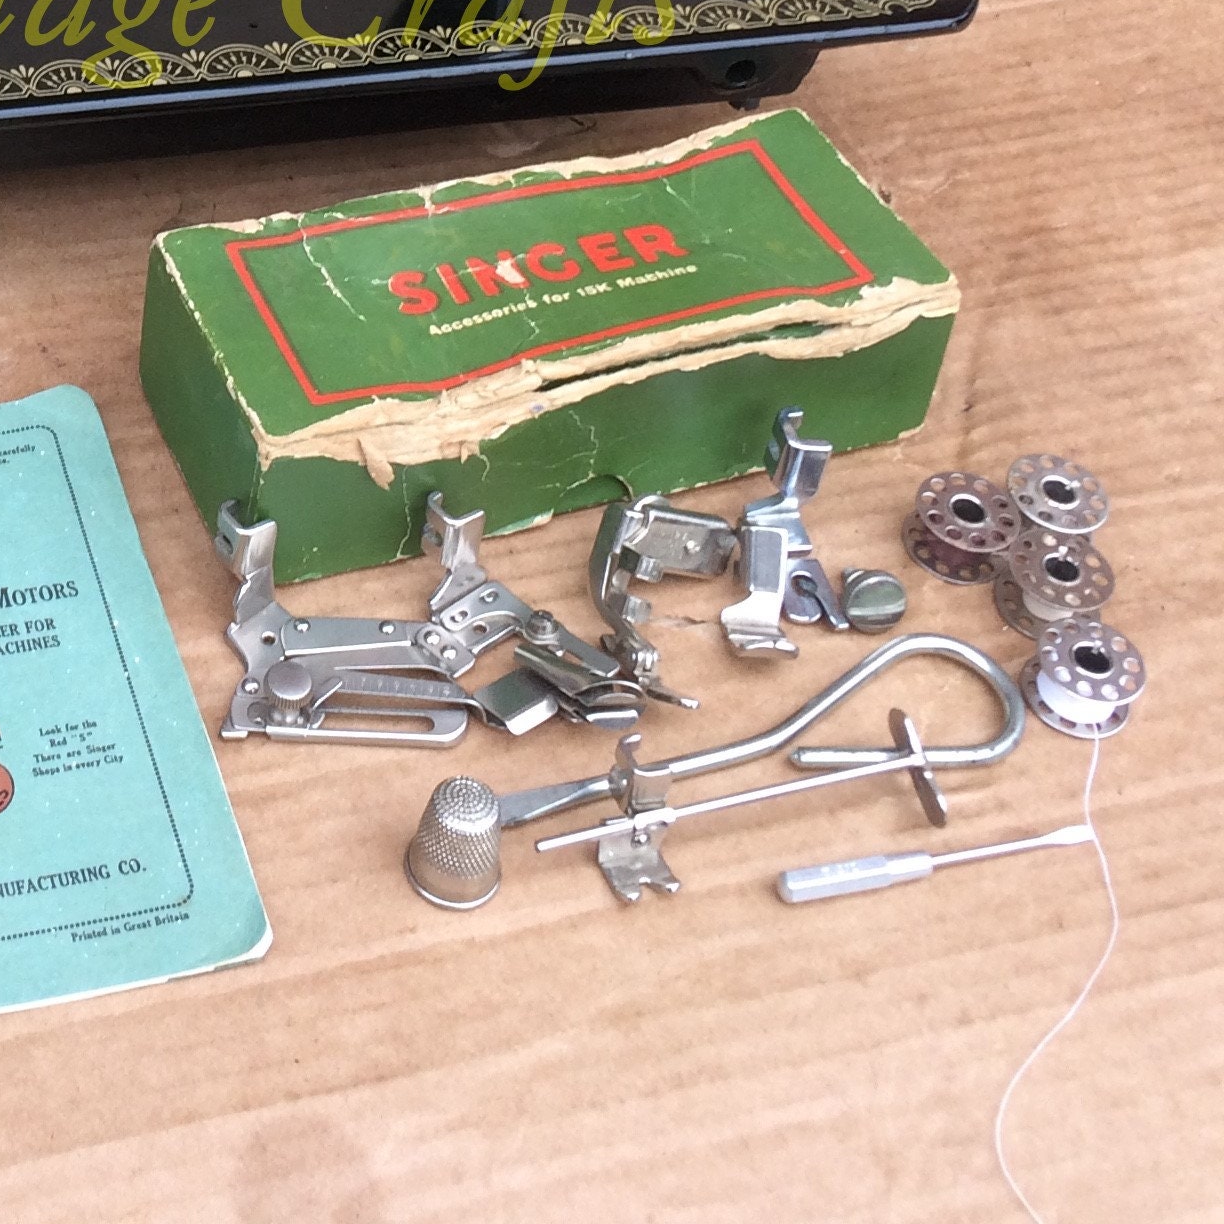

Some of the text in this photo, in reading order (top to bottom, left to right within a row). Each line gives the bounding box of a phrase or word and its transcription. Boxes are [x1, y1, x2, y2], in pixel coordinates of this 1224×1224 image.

[388, 223, 689, 315] SINGER
[429, 264, 697, 337] Accessories for 15K Machine
[24, 617, 57, 633] FOR
[39, 719, 97, 737] Look for the
[33, 742, 116, 763] There are Singer
[49, 737, 67, 748] Red
[32, 765, 60, 778] Shops
[75, 756, 101, 769] every
[104, 752, 124, 764] City
[117, 857, 147, 875] CO.
[70, 911, 190, 943] Printed in Great Britain
